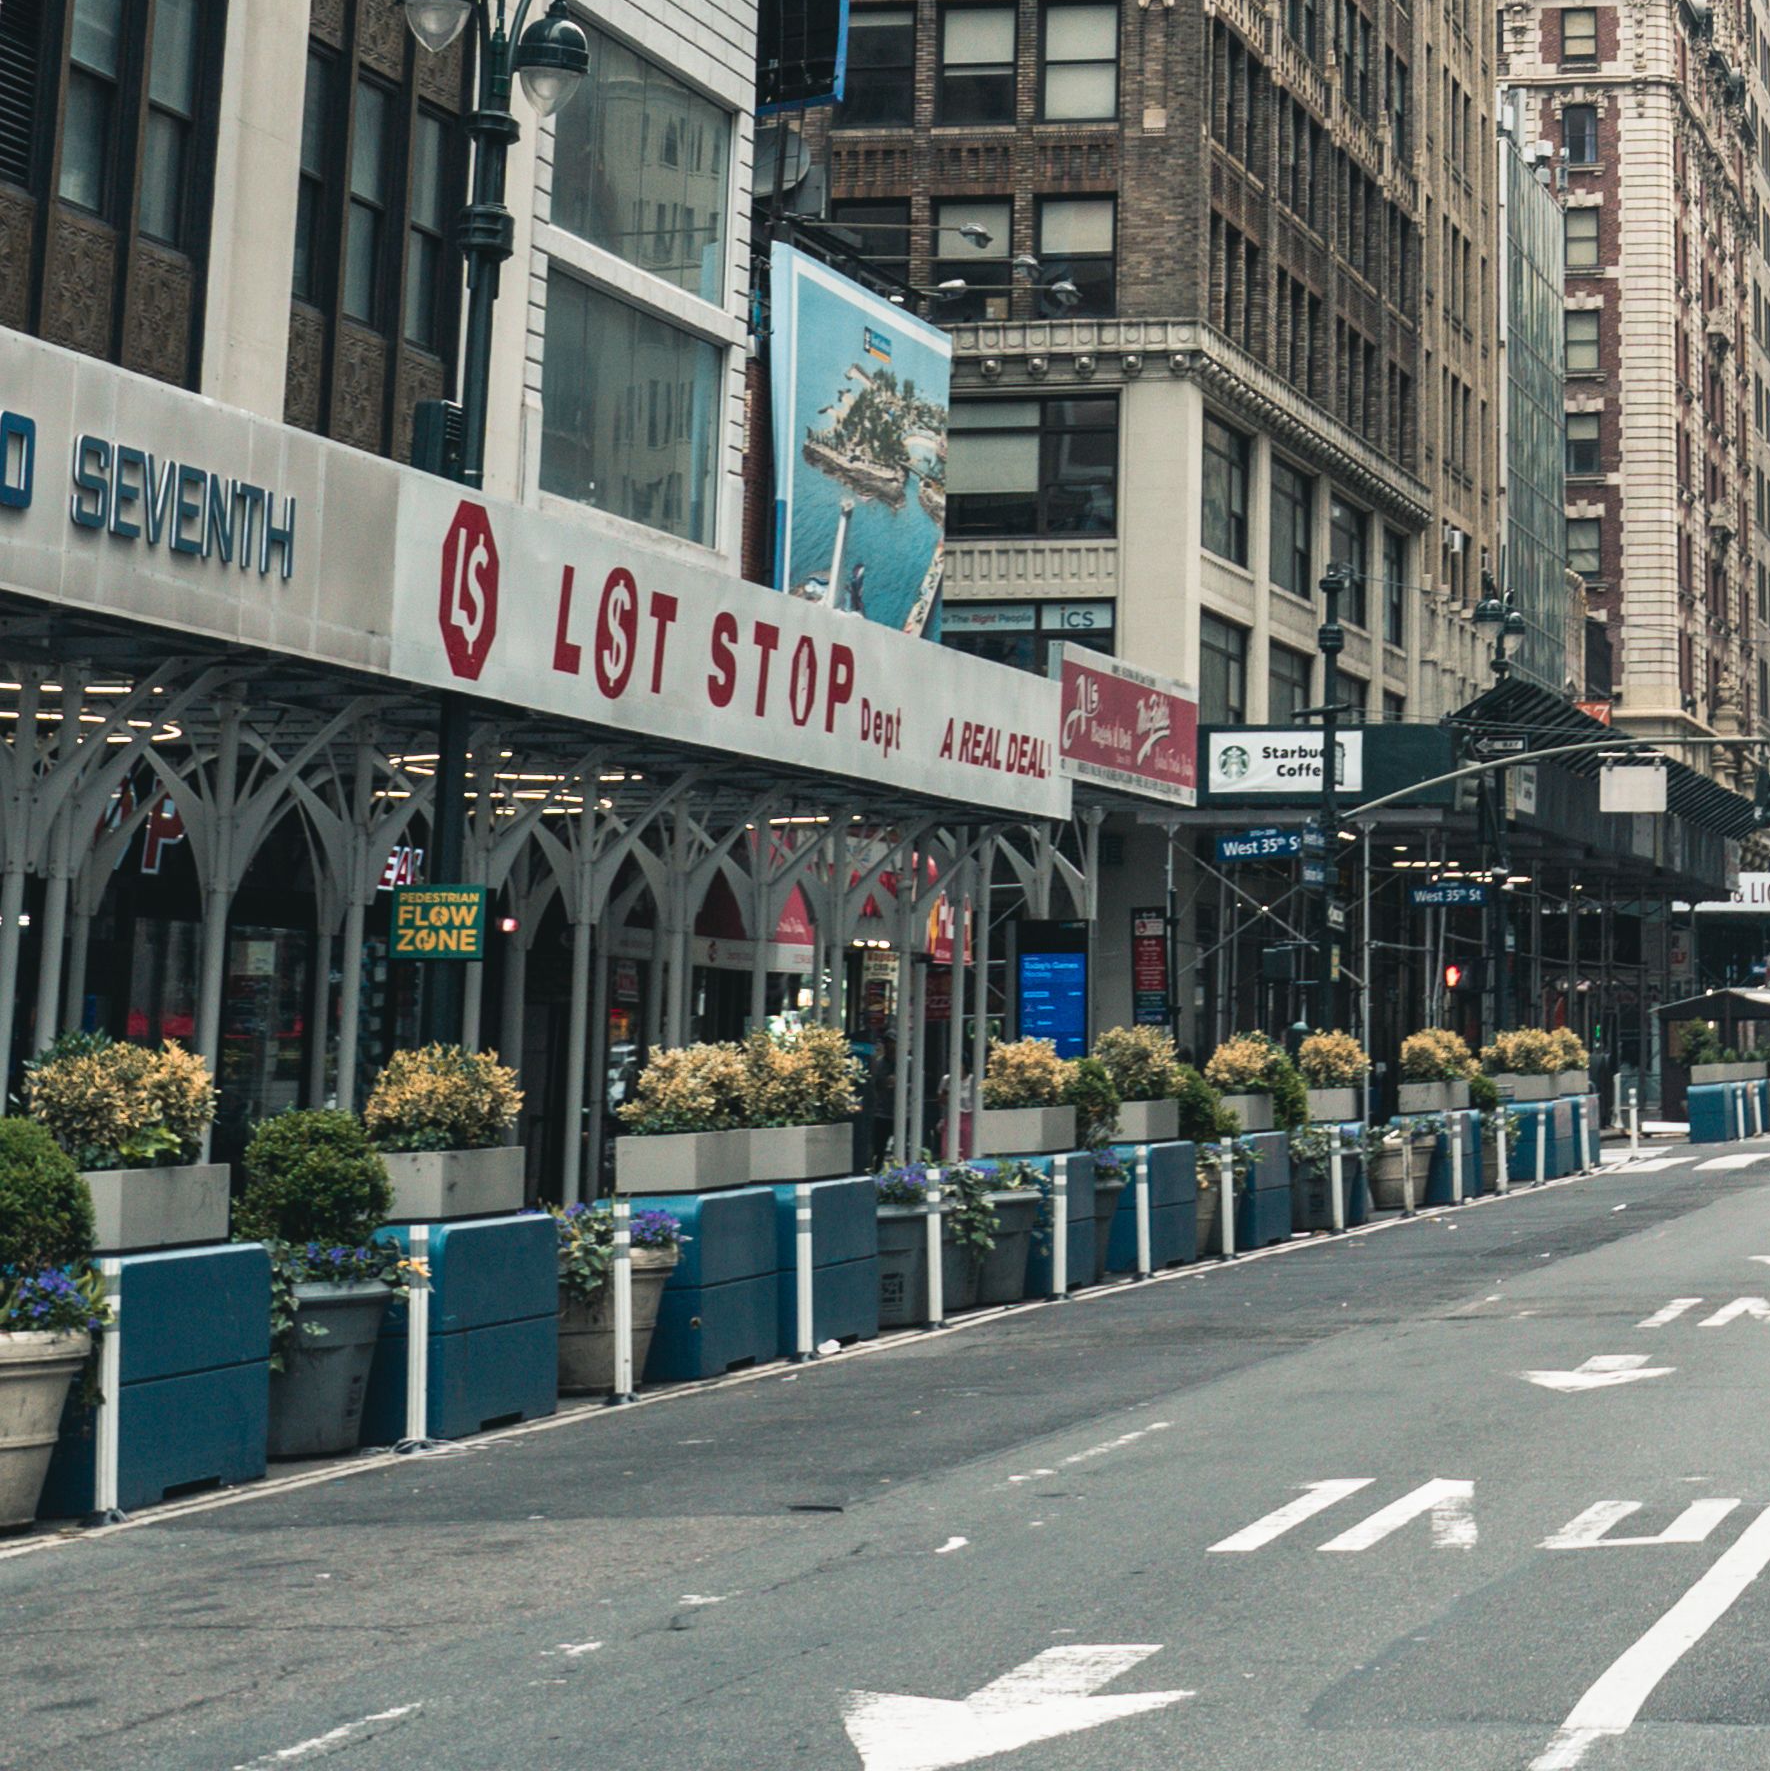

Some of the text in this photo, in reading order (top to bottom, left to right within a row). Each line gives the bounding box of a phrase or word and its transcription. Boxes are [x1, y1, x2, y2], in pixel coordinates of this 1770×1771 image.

[70, 434, 297, 580] SEVENTH
[971, 613, 996, 626] Right
[998, 611, 1033, 623] People
[861, 696, 903, 757] Dept
[940, 717, 956, 759] A
[958, 719, 1002, 766] REAL
[1276, 762, 1323, 778] Coffe
[1222, 841, 1259, 857] West
[1261, 837, 1287, 854] 35th
[398, 892, 480, 905] PEDESTRIAN
[1414, 887, 1482, 903] West 35th St
[397, 905, 478, 927] FLOW
[396, 927, 478, 952] ZONE
